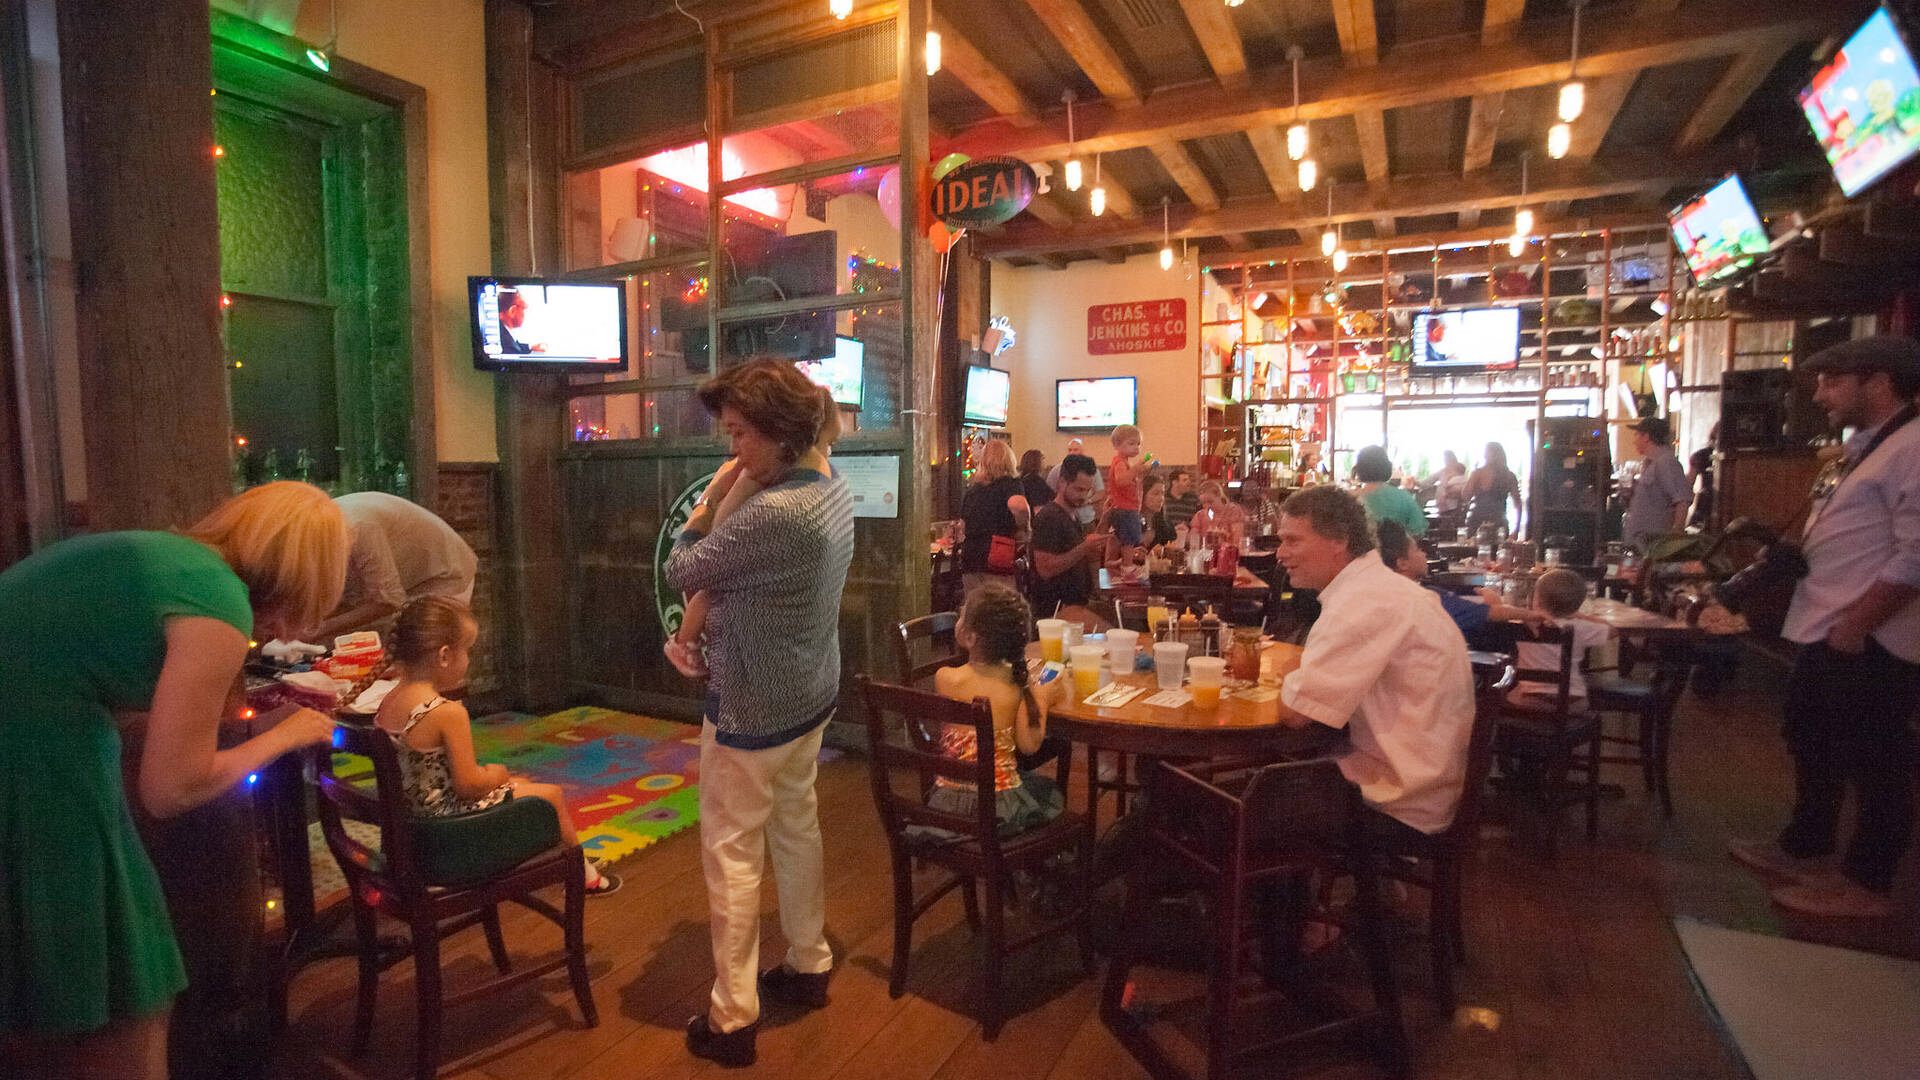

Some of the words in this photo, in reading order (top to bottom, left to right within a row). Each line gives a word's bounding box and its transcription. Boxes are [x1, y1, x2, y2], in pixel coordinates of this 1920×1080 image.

[1102, 304, 1147, 322] CHAS.
[1159, 302, 1174, 317] H.
[1089, 322, 1150, 341] JENKINS
